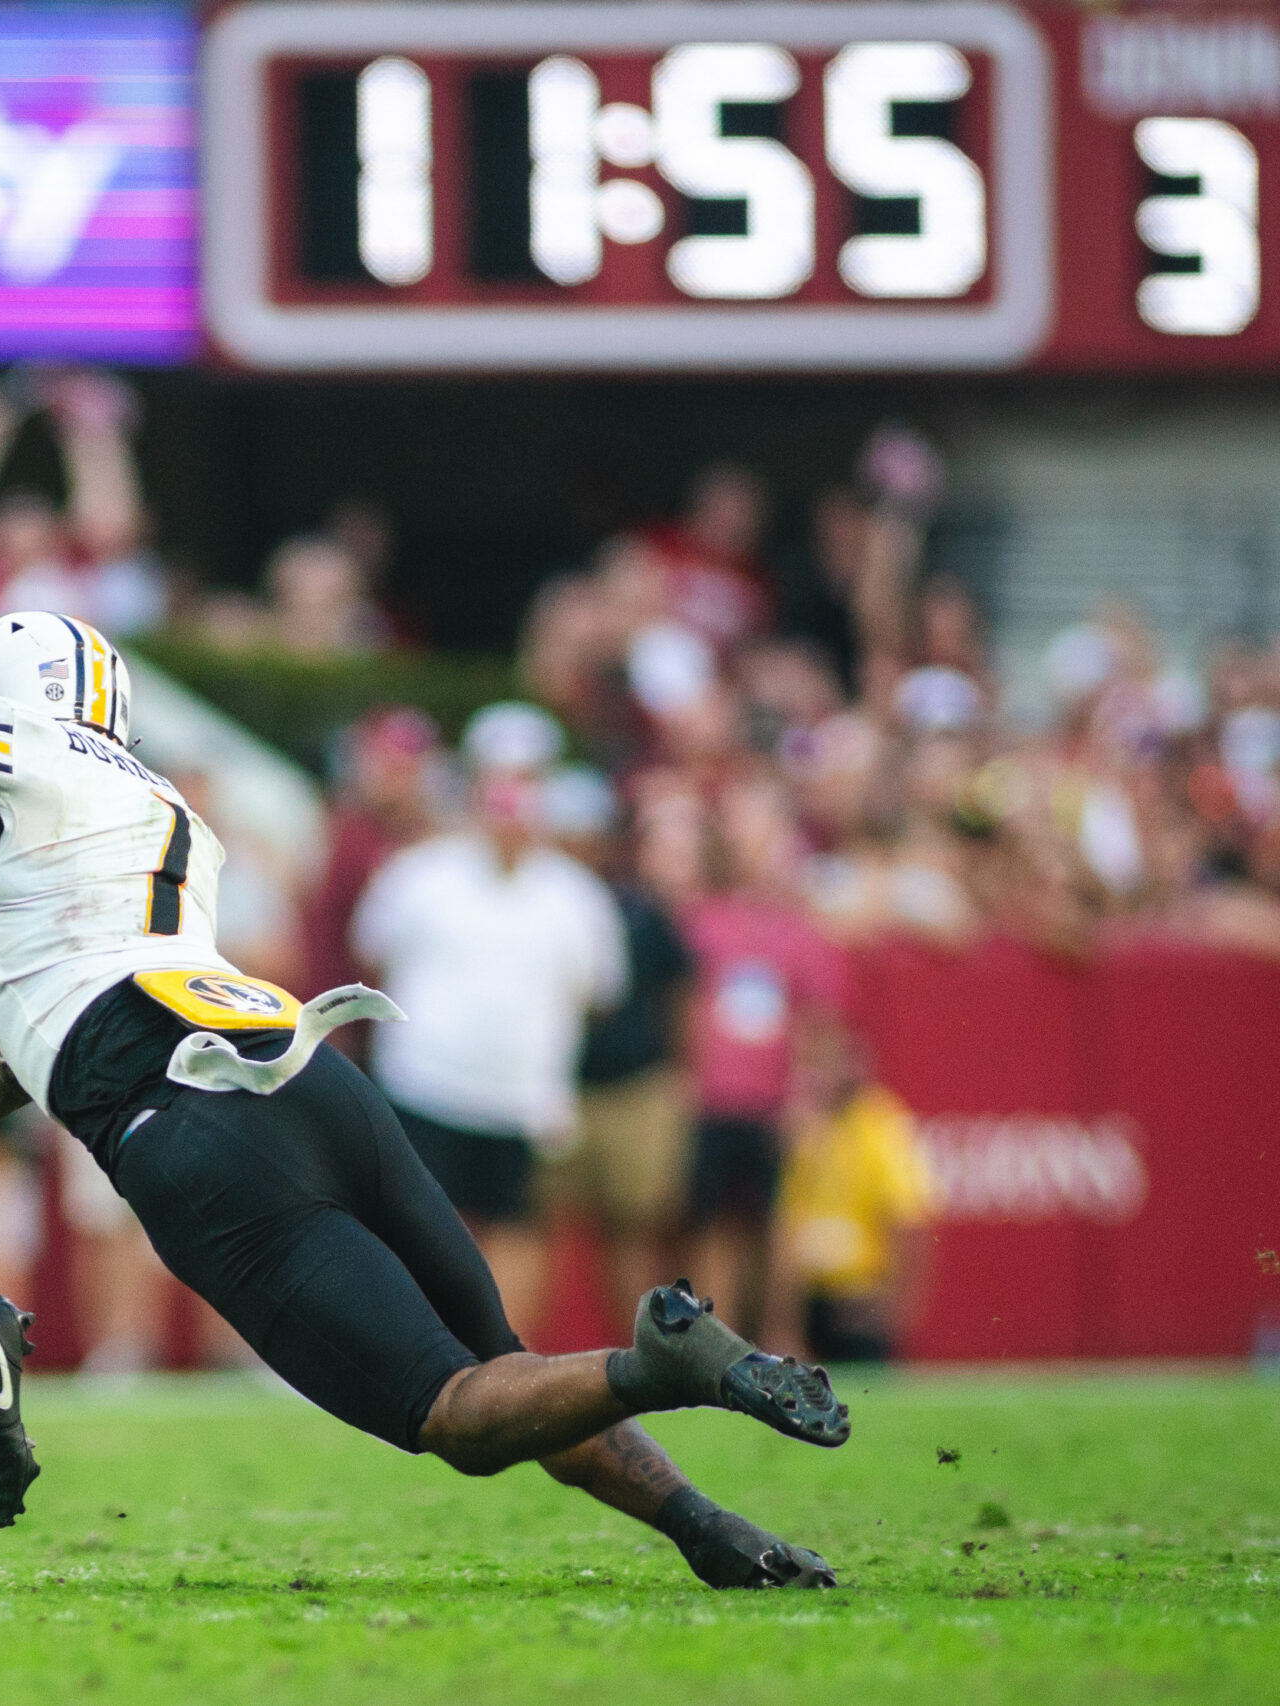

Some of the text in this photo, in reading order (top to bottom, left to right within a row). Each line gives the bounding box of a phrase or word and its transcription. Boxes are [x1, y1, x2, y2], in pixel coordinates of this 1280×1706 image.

[356, 40, 987, 299] 11:55
[1133, 116, 1260, 336] 3
[144, 791, 191, 936] 1
